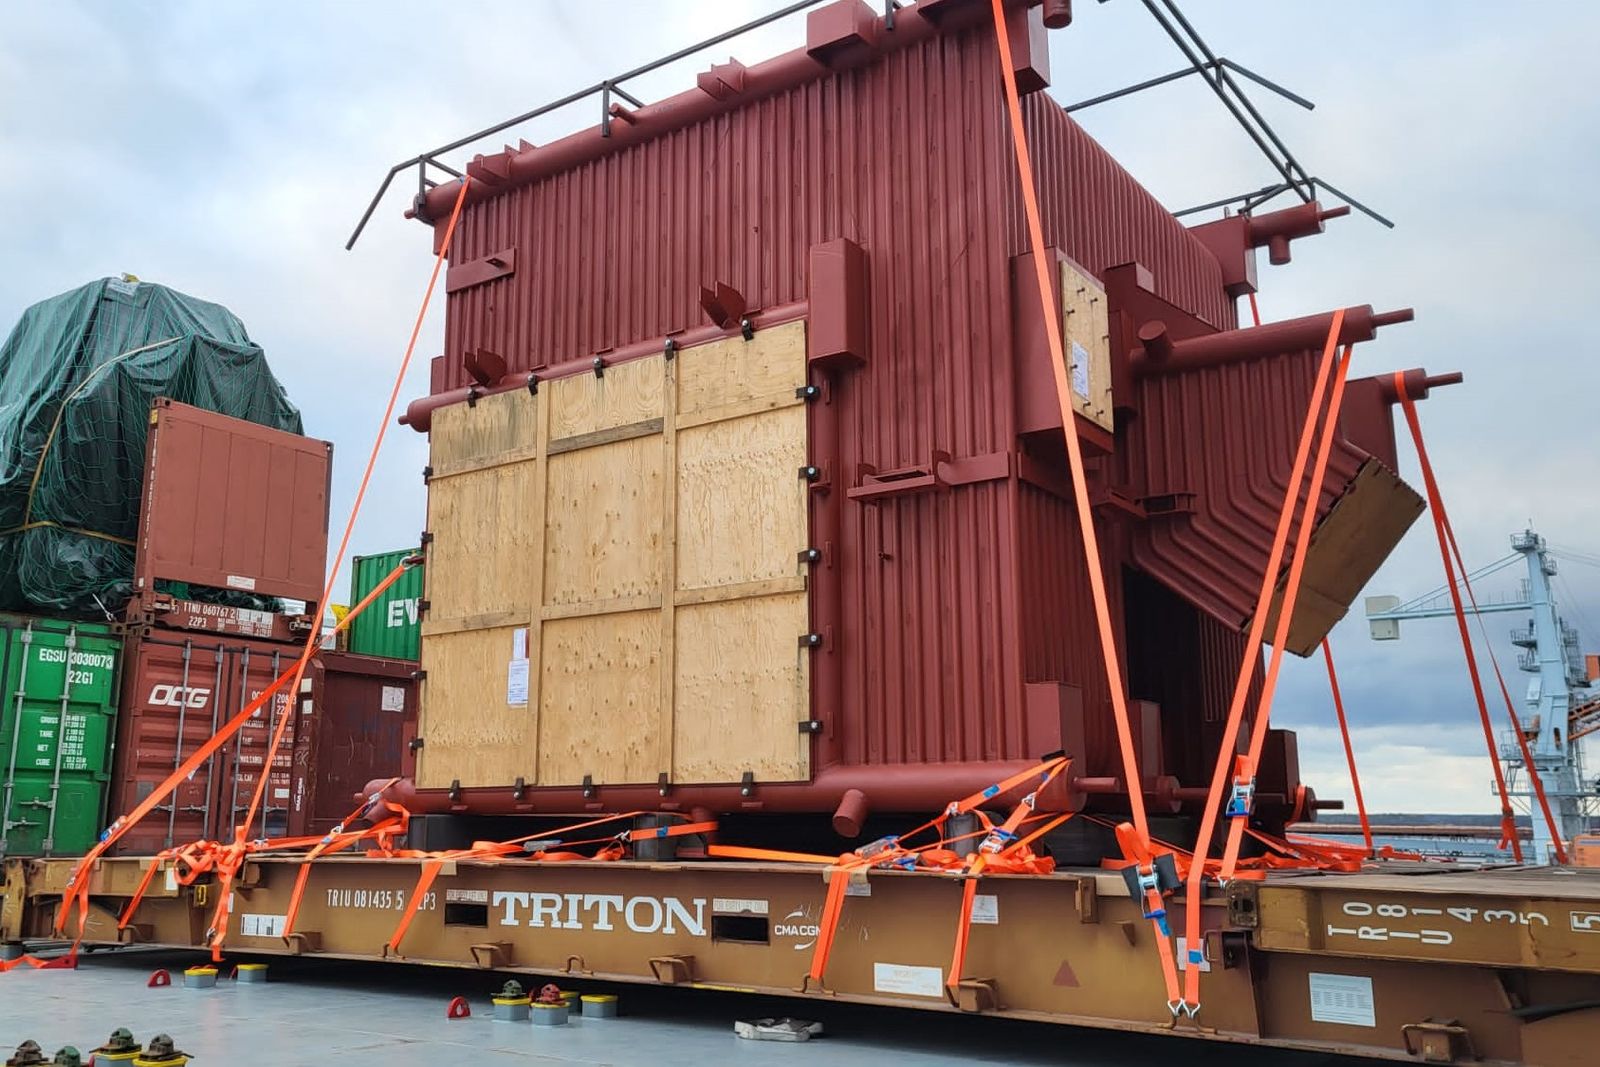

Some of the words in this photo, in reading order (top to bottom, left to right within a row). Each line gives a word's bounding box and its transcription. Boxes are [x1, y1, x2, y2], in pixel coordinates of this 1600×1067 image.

[183, 601, 201, 614] TTNU
[202, 604, 229, 617] 060767
[188, 615, 207, 628] 22P3
[39, 648, 67, 663] EGSU
[327, 889, 351, 907] TRIU
[354, 890, 392, 909] 081435
[396, 890, 404, 910] 5
[492, 890, 707, 937] TRITON
[774, 924, 799, 936] CMA
